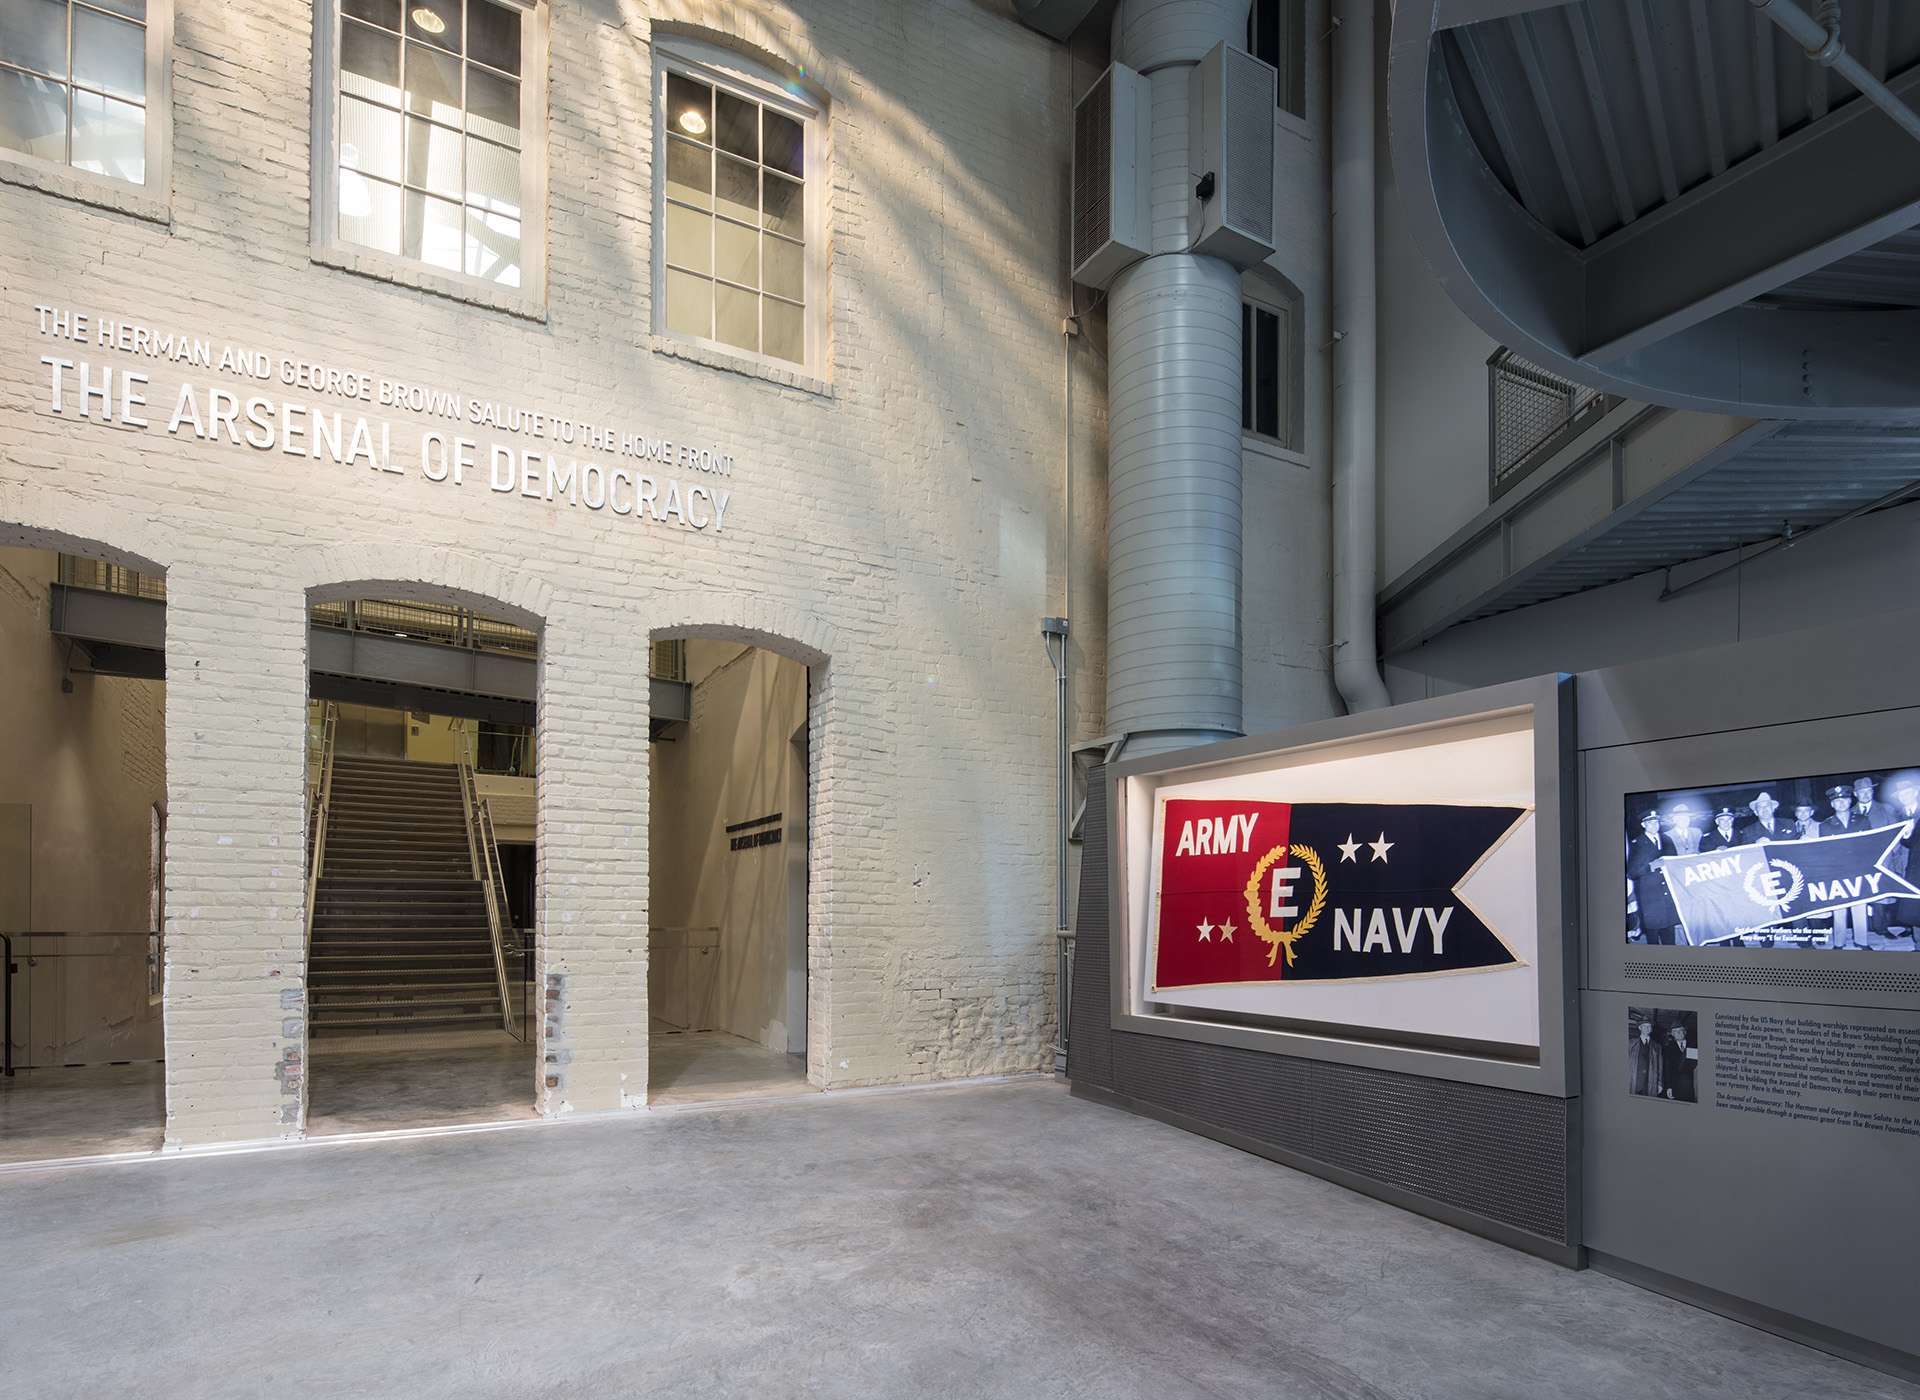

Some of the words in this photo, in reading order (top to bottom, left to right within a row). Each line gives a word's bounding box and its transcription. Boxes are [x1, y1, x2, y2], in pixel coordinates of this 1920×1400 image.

[35, 304, 88, 343] THE
[99, 318, 210, 368] HERMAN
[219, 346, 272, 379] AND
[280, 358, 372, 402] GEORGE
[378, 379, 461, 420] BROWN
[468, 399, 544, 439] SALUTE
[550, 417, 575, 443] TO
[580, 423, 615, 453] THE
[621, 431, 673, 465] HOME
[678, 446, 734, 477] FRONT
[40, 355, 149, 429] THE
[168, 383, 404, 475] ARSENAL
[421, 431, 476, 486] OF
[490, 443, 730, 532] DEMOCRACY
[1175, 812, 1260, 857] ARMY
[1269, 867, 1302, 918] E
[1684, 854, 1742, 887] ARMY
[1760, 870, 1787, 897] E
[1807, 872, 1883, 902] NAVY
[1333, 906, 1454, 955] NAVY
